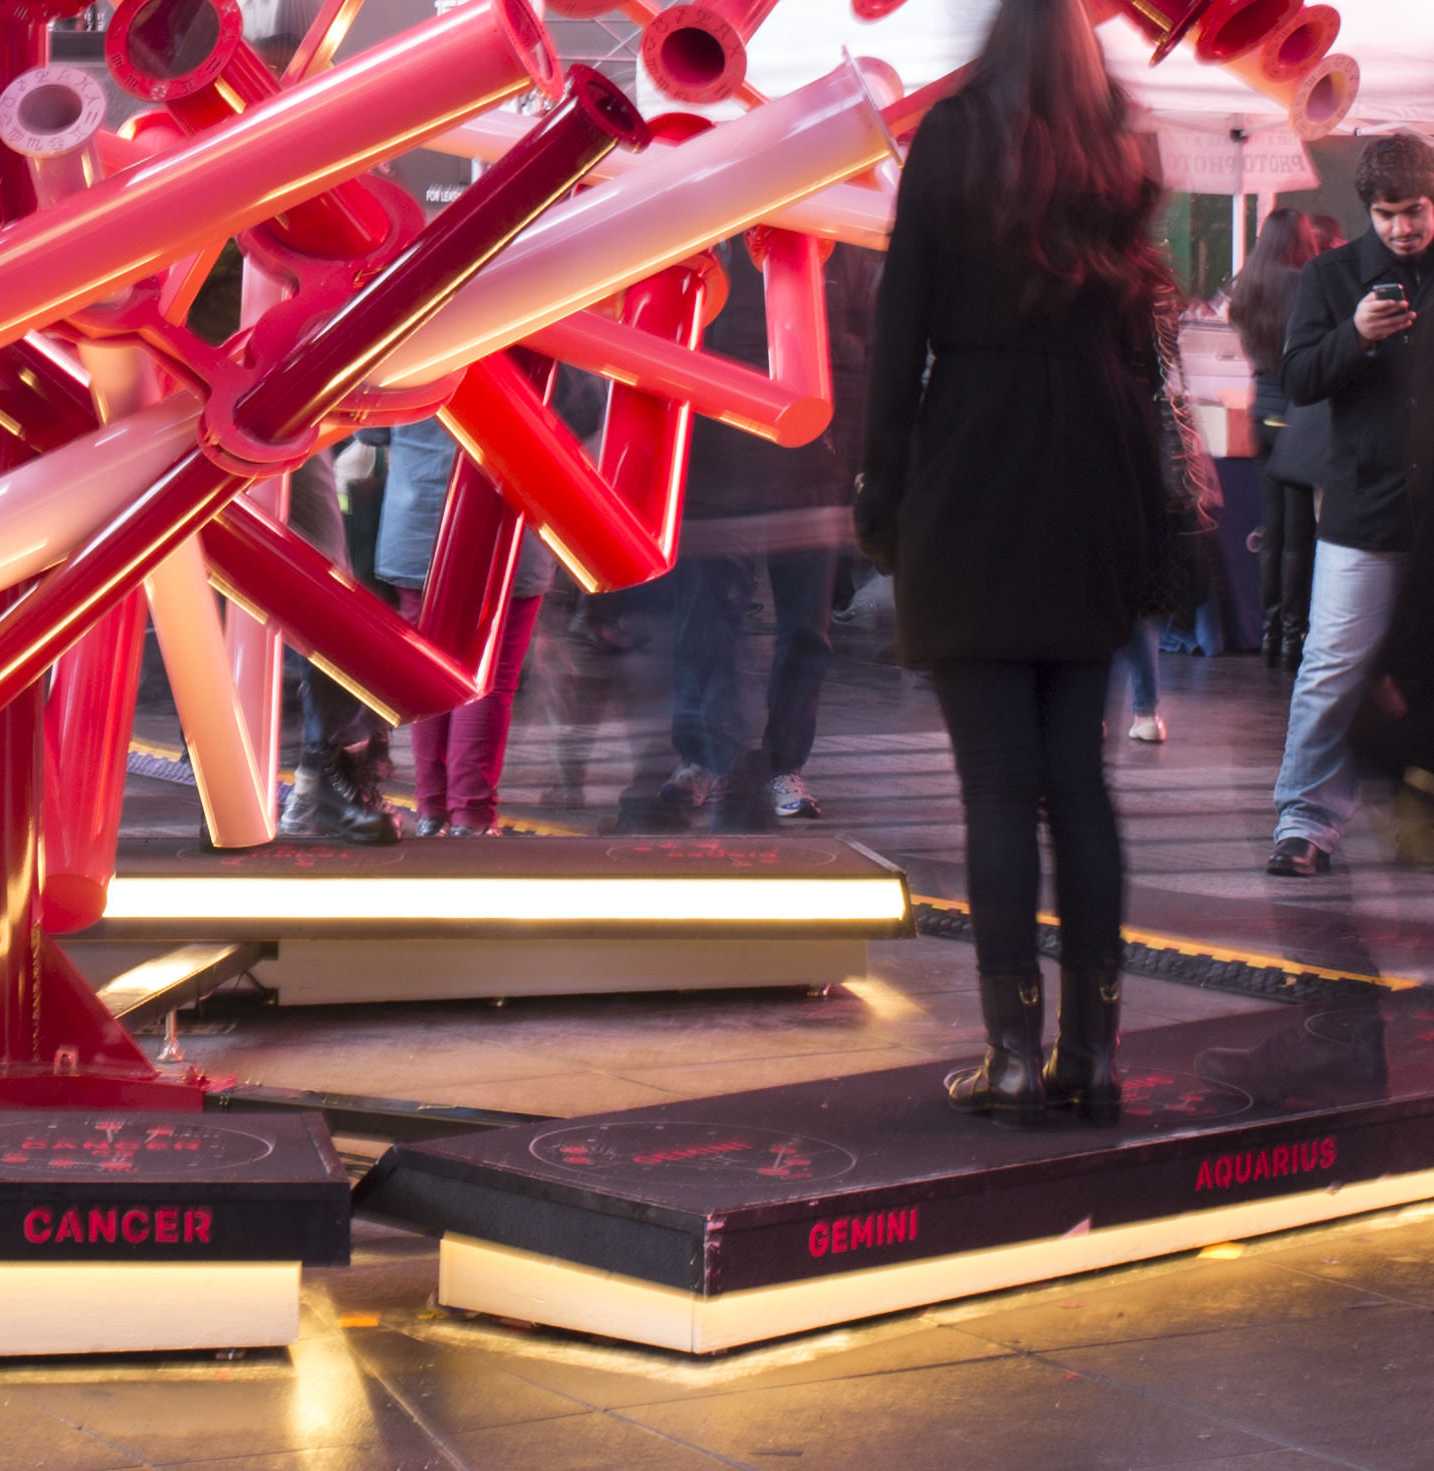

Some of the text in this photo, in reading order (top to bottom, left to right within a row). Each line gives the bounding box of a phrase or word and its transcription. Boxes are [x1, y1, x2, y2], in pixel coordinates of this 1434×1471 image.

[1194, 1135, 1338, 1193] AQUARIUS
[23, 1207, 214, 1244] CANCER
[808, 1210, 919, 1259] GEMINI
